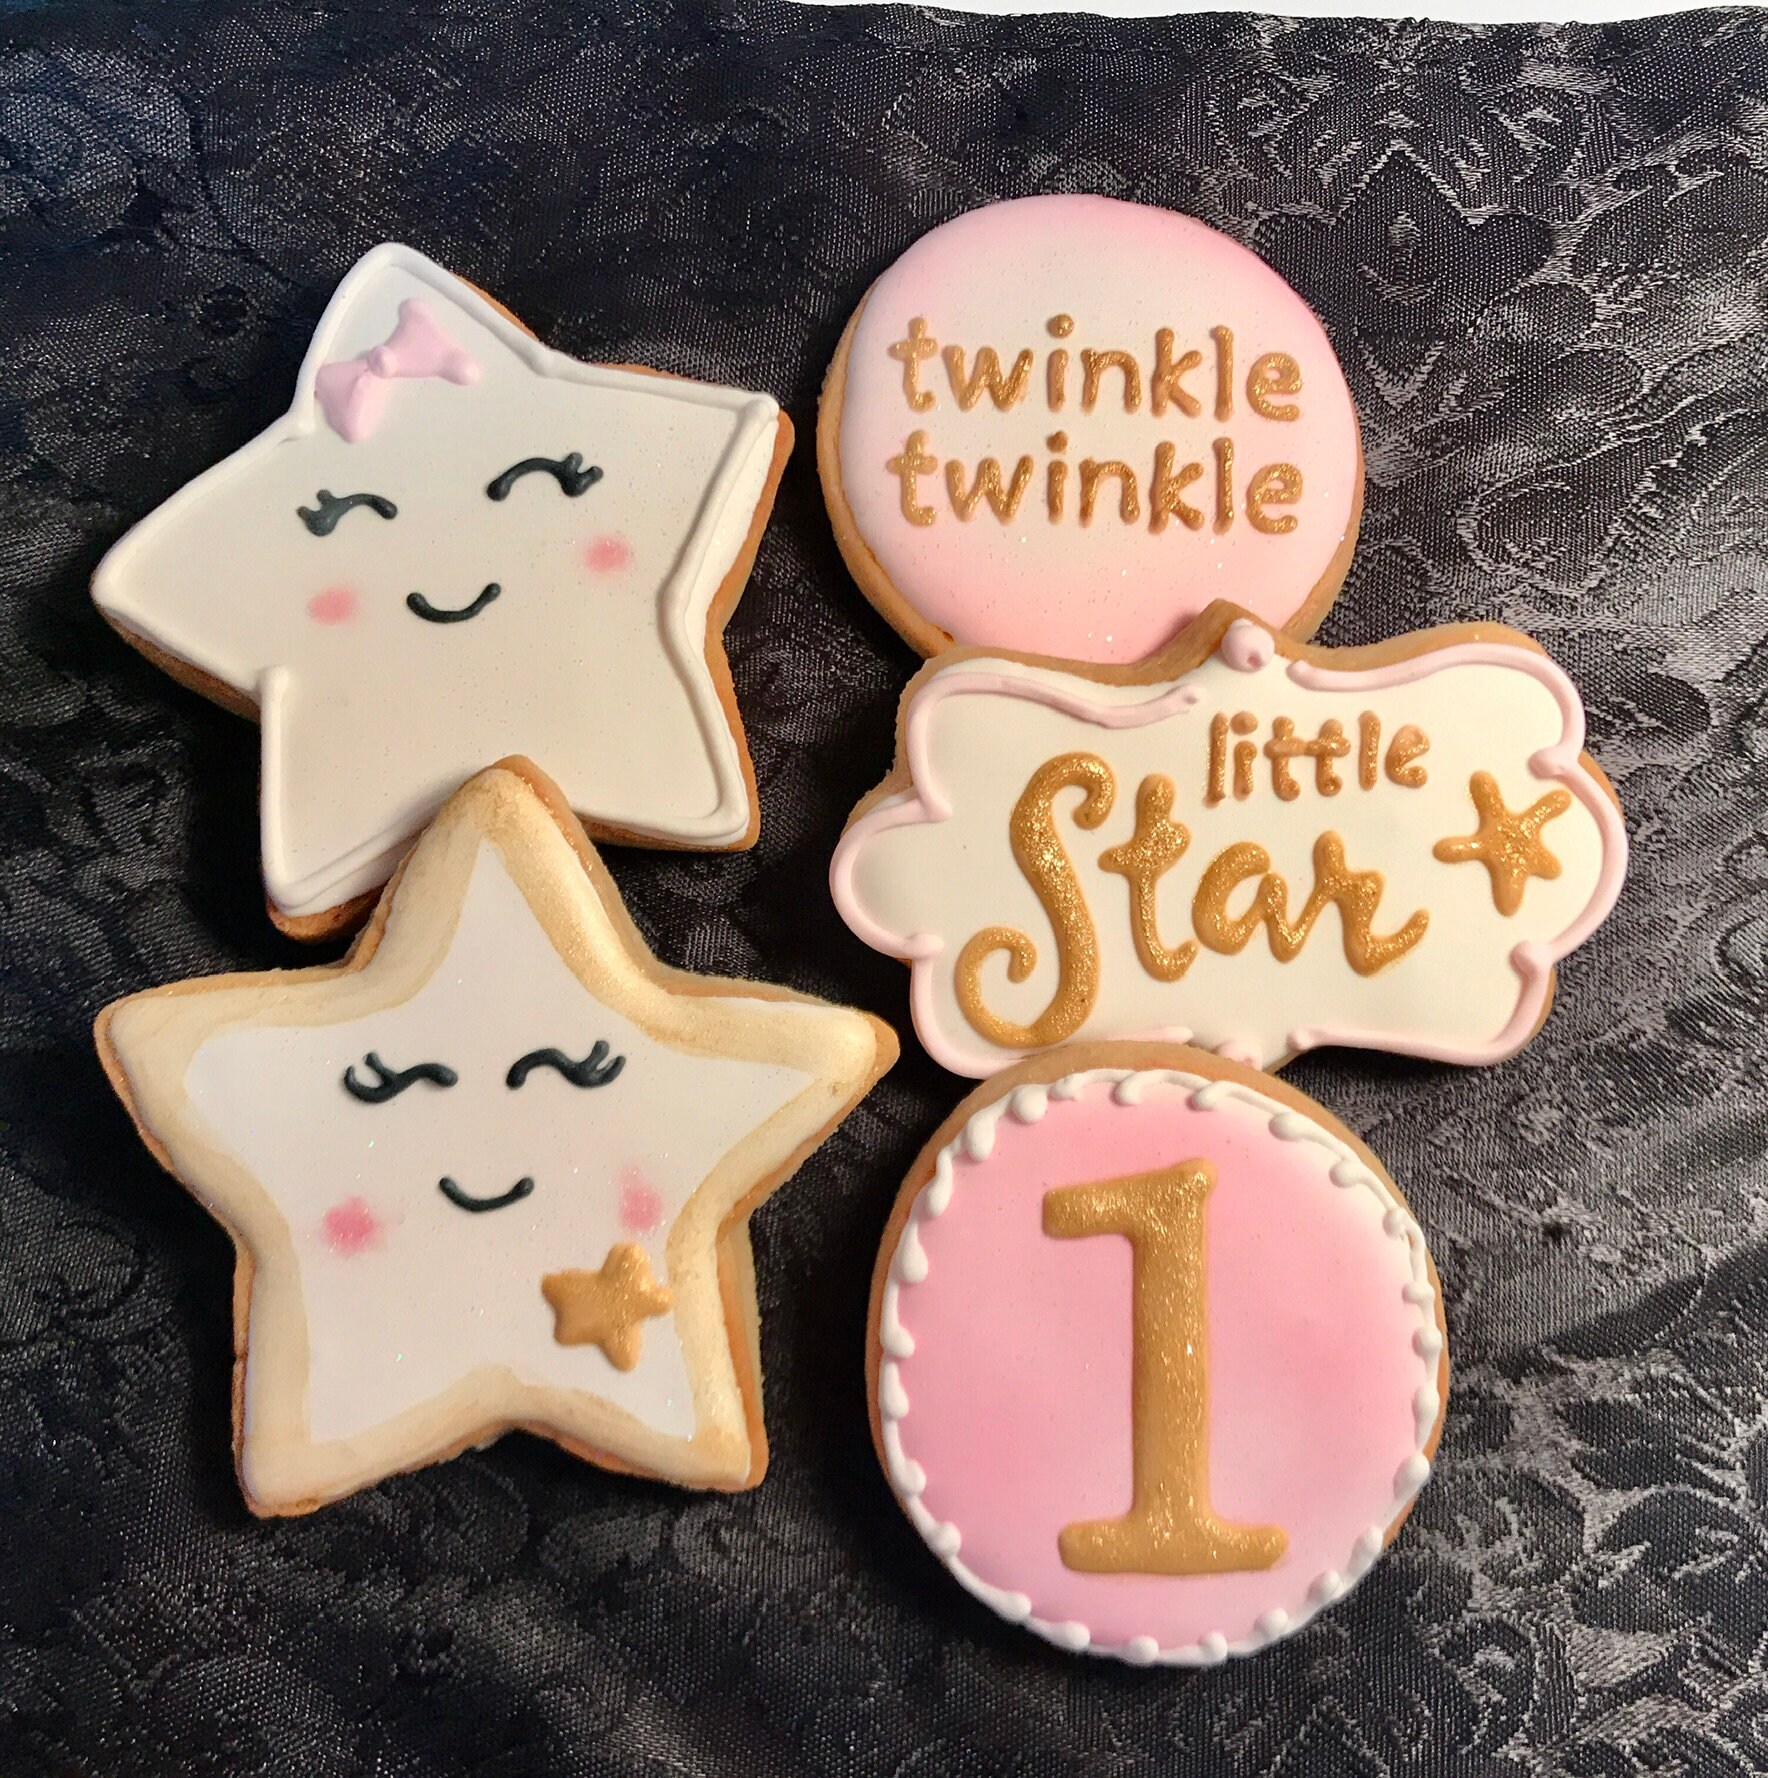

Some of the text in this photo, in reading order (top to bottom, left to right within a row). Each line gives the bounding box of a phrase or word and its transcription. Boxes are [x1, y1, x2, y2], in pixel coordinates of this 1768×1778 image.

[888, 314, 1303, 422] twinkle
[886, 430, 1304, 535] twinkle
[1202, 710, 1430, 808] little
[954, 751, 1430, 1048] Star
[1041, 1157, 1289, 1577] 1
